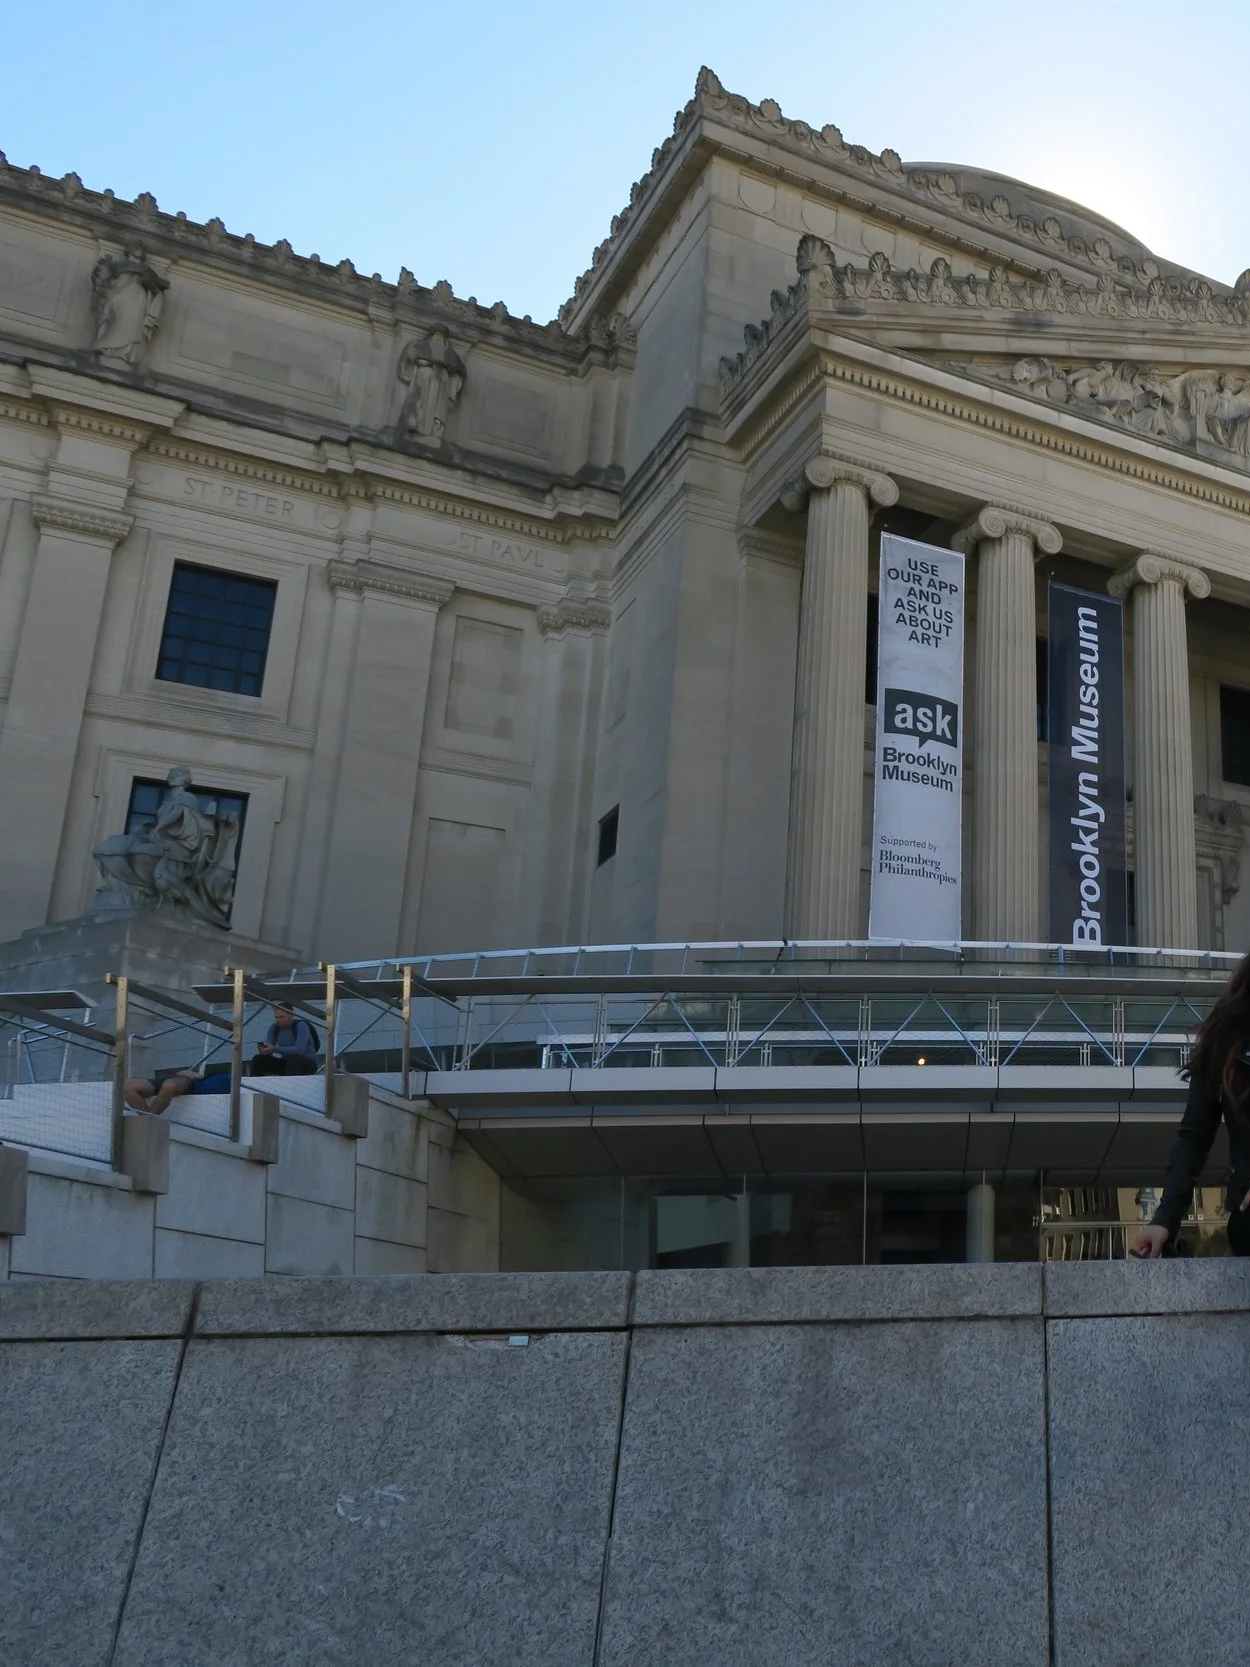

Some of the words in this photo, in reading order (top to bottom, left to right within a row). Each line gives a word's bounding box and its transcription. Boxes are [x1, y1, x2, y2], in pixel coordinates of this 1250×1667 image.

[220, 485, 295, 519] PETER
[908, 558, 939, 577] USE
[887, 568, 922, 586] OUR
[927, 578, 958, 595] APP
[907, 586, 941, 605] AND
[893, 598, 929, 616] ASK
[933, 607, 953, 624] US
[895, 613, 952, 637] ABOUT
[908, 630, 941, 648] ART
[1071, 606, 1099, 764] Museum
[894, 703, 952, 740] ask
[883, 747, 957, 776] Brooklyn
[882, 765, 953, 792] Museum
[880, 835, 926, 849] Supported
[928, 841, 937, 852] by
[880, 850, 941, 871] Bloomberg
[1071, 771, 1105, 947] Brooklyn
[879, 862, 957, 885] Philanthropies
